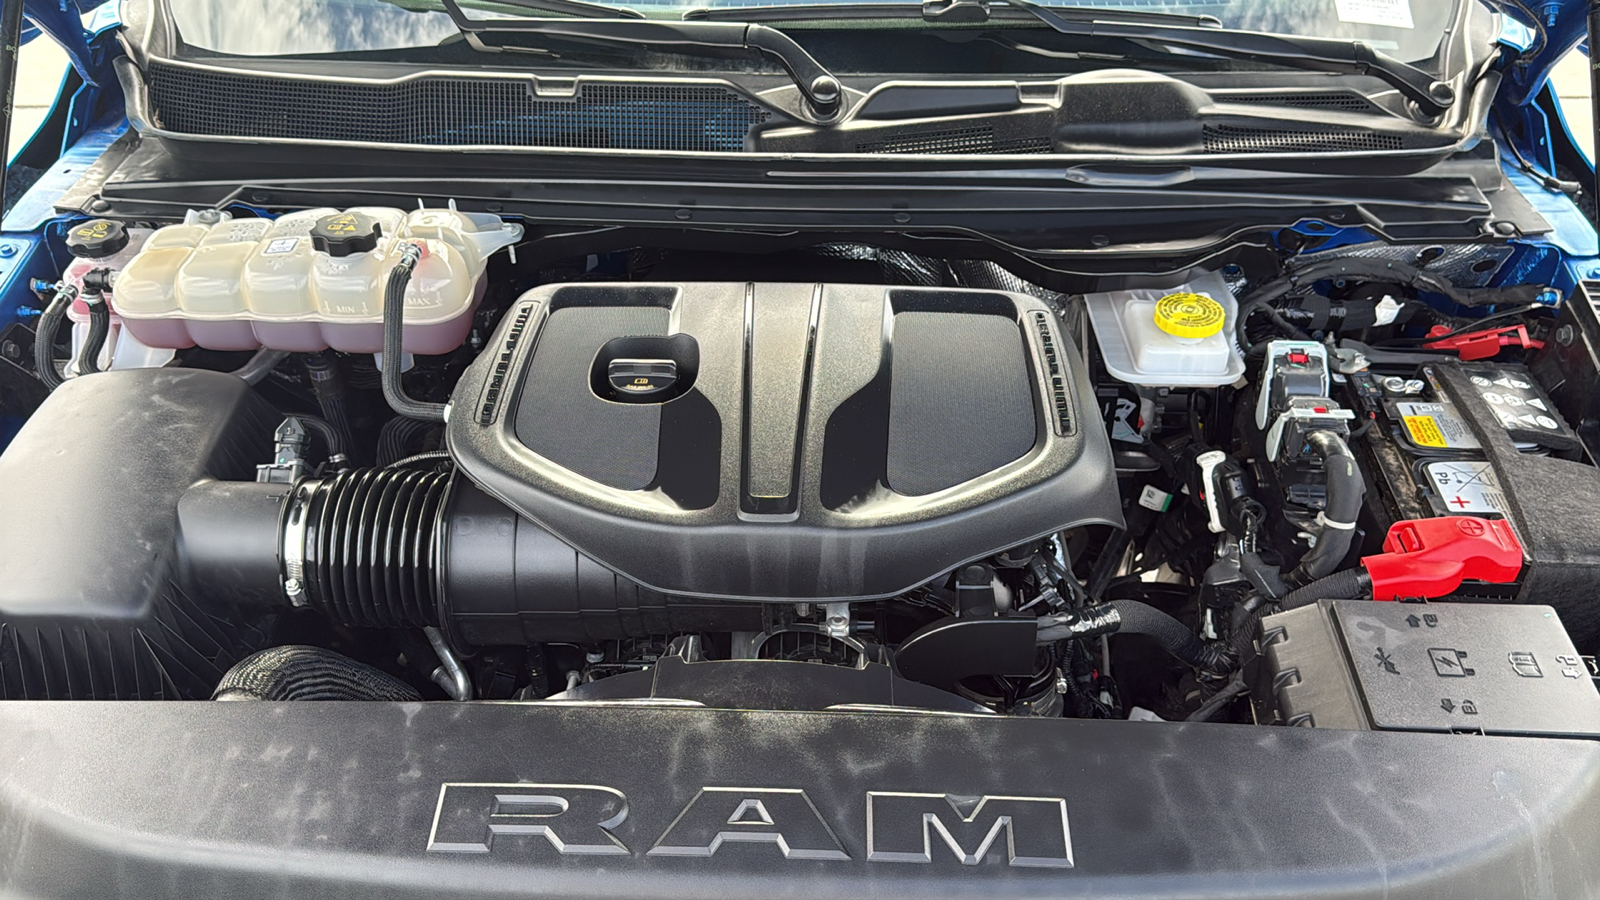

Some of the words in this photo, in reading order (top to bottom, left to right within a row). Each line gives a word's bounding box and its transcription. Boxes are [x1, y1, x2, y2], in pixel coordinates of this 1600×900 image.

[408, 297, 431, 306] MAX
[336, 305, 356, 314] MIN
[1434, 471, 1452, 485] Pb
[426, 782, 1075, 868] RAM
